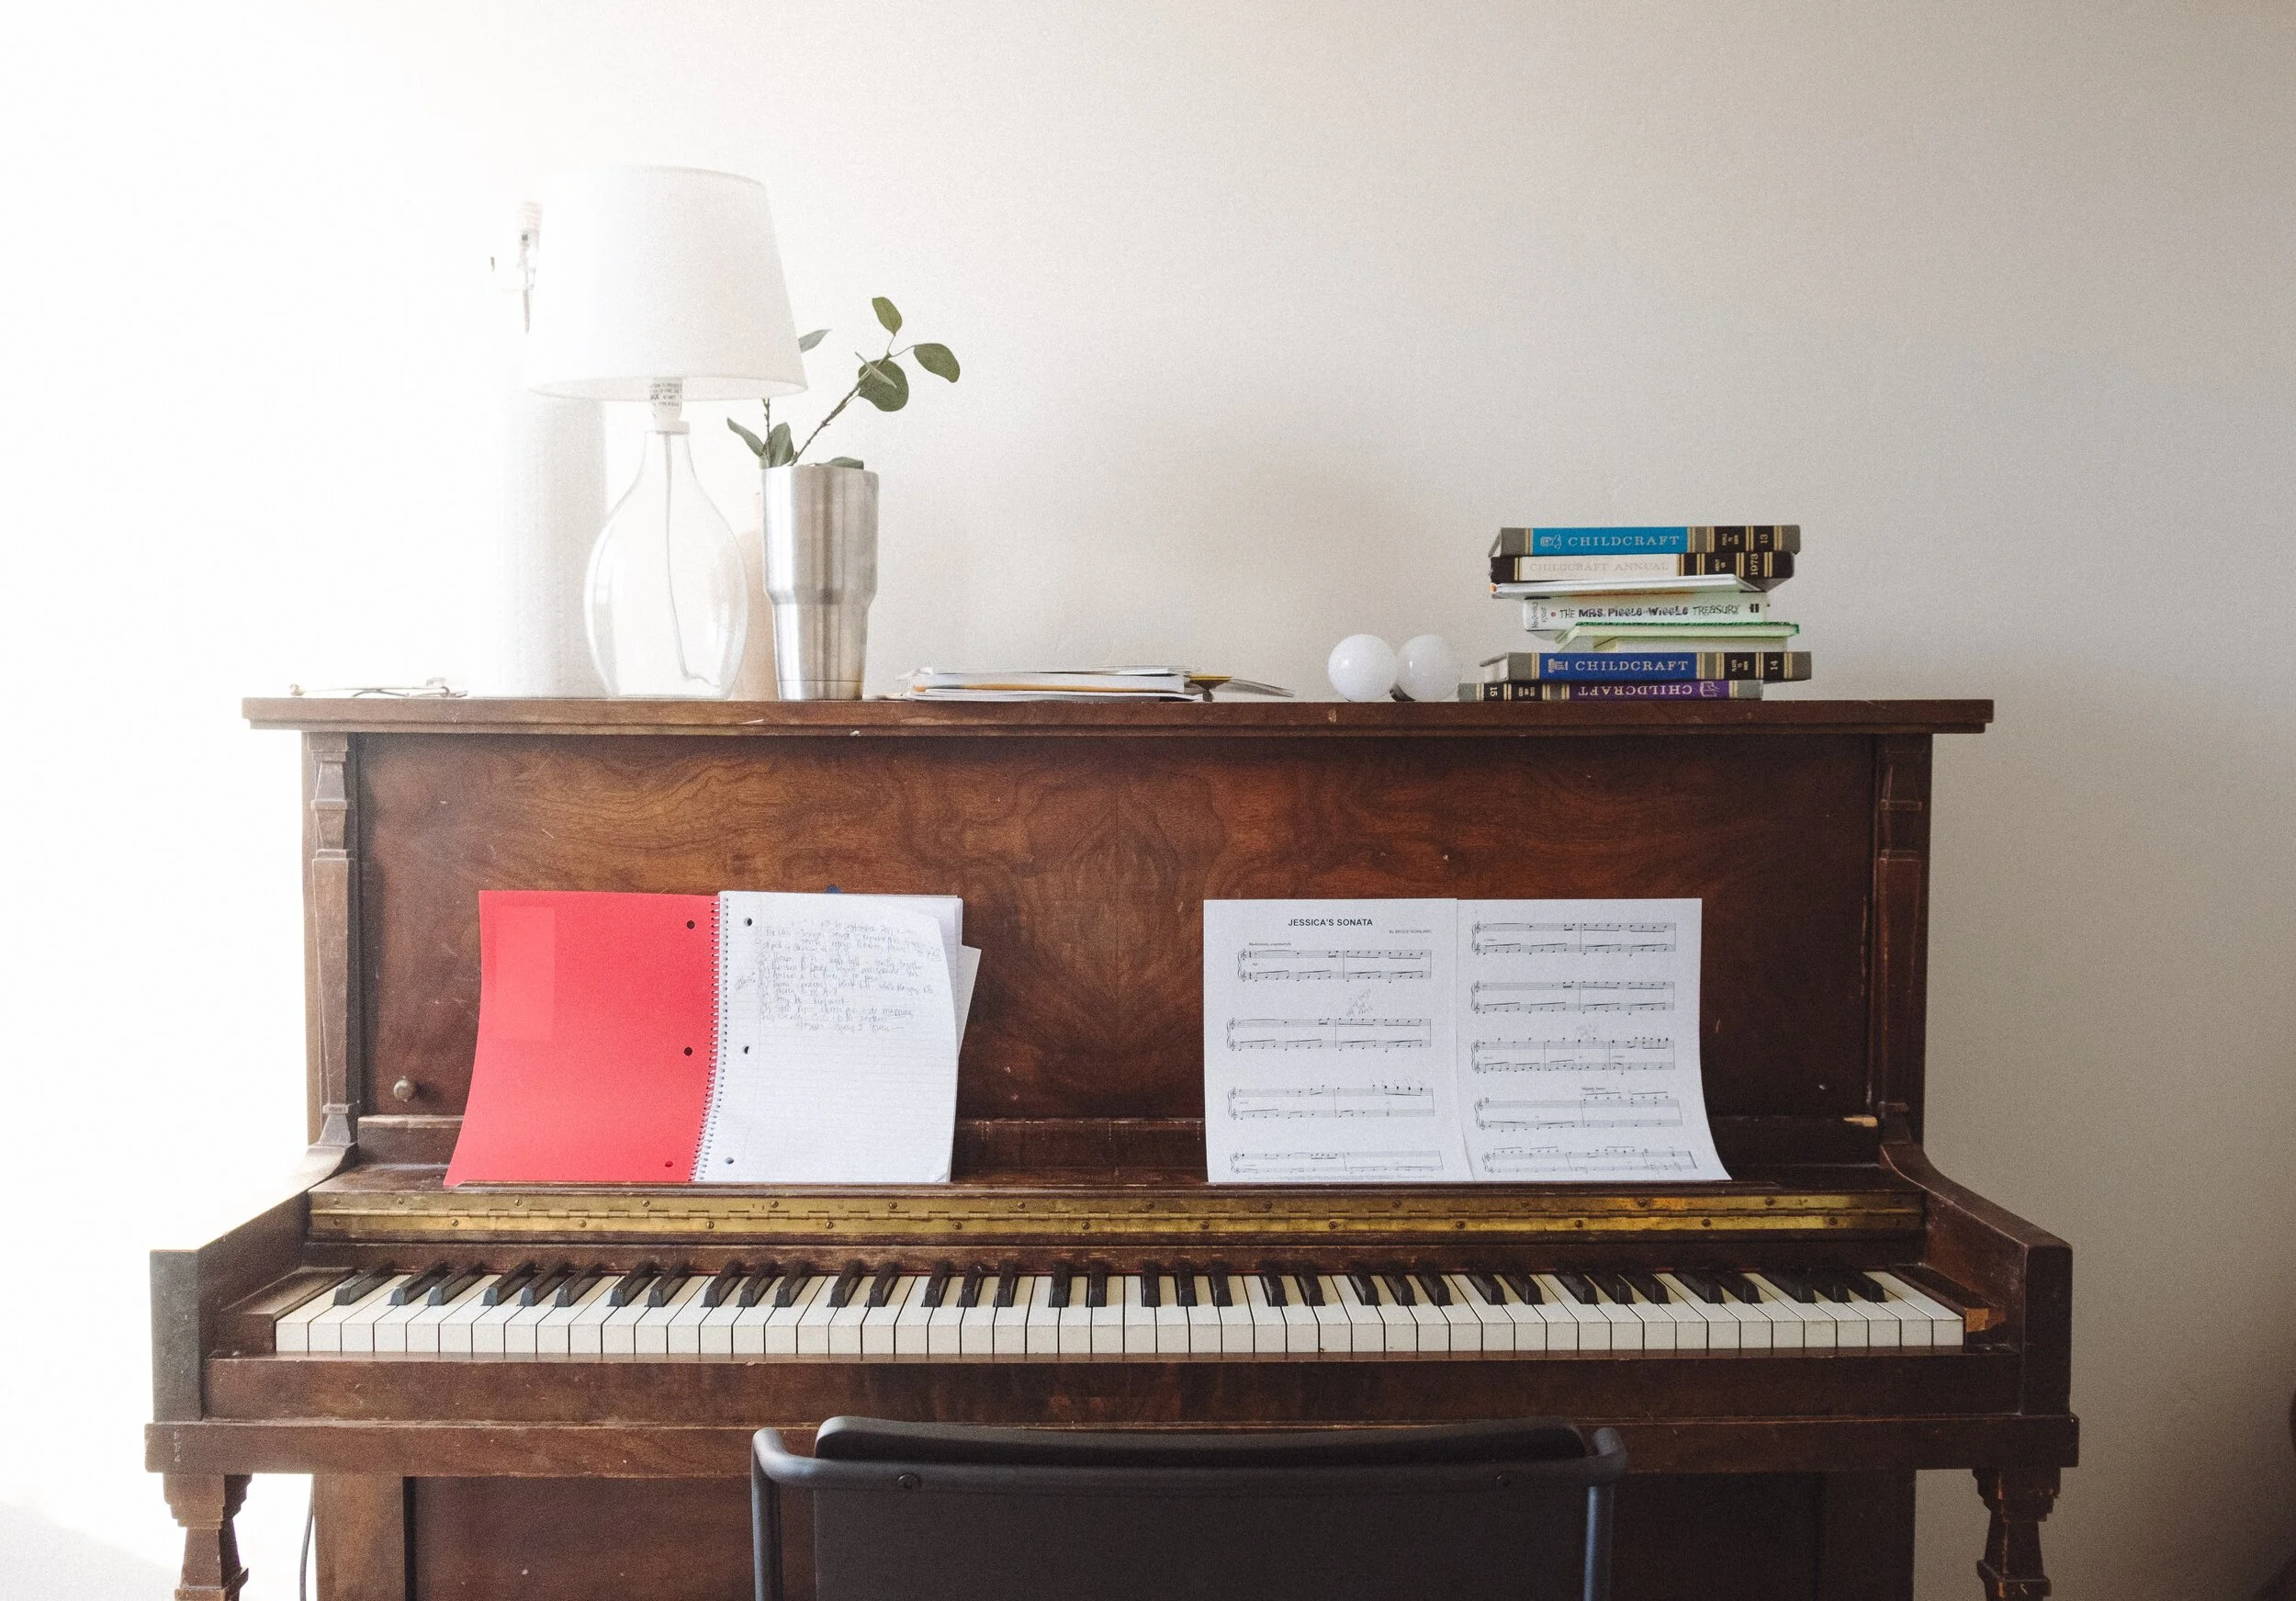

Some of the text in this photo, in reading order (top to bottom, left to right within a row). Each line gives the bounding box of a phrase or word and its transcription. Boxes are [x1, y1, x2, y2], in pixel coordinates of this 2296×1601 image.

[1568, 536, 1681, 547] CHILDCRAFT
[1760, 534, 1769, 544] 13
[1529, 561, 1671, 572] CHILDCRAFT ANNUAL
[1750, 553, 1759, 576] 1973
[1559, 608, 1576, 619] THE
[1578, 608, 1606, 618] MRS.
[1692, 604, 1741, 616] TREASURY
[1575, 660, 1689, 671] CHILDCRAFT
[1770, 660, 1778, 671] 14
[1490, 686, 1498, 697] 15
[1578, 684, 1693, 697] CHILDCRAFT
[1288, 919, 1374, 927] JESSICA'S SONATA
